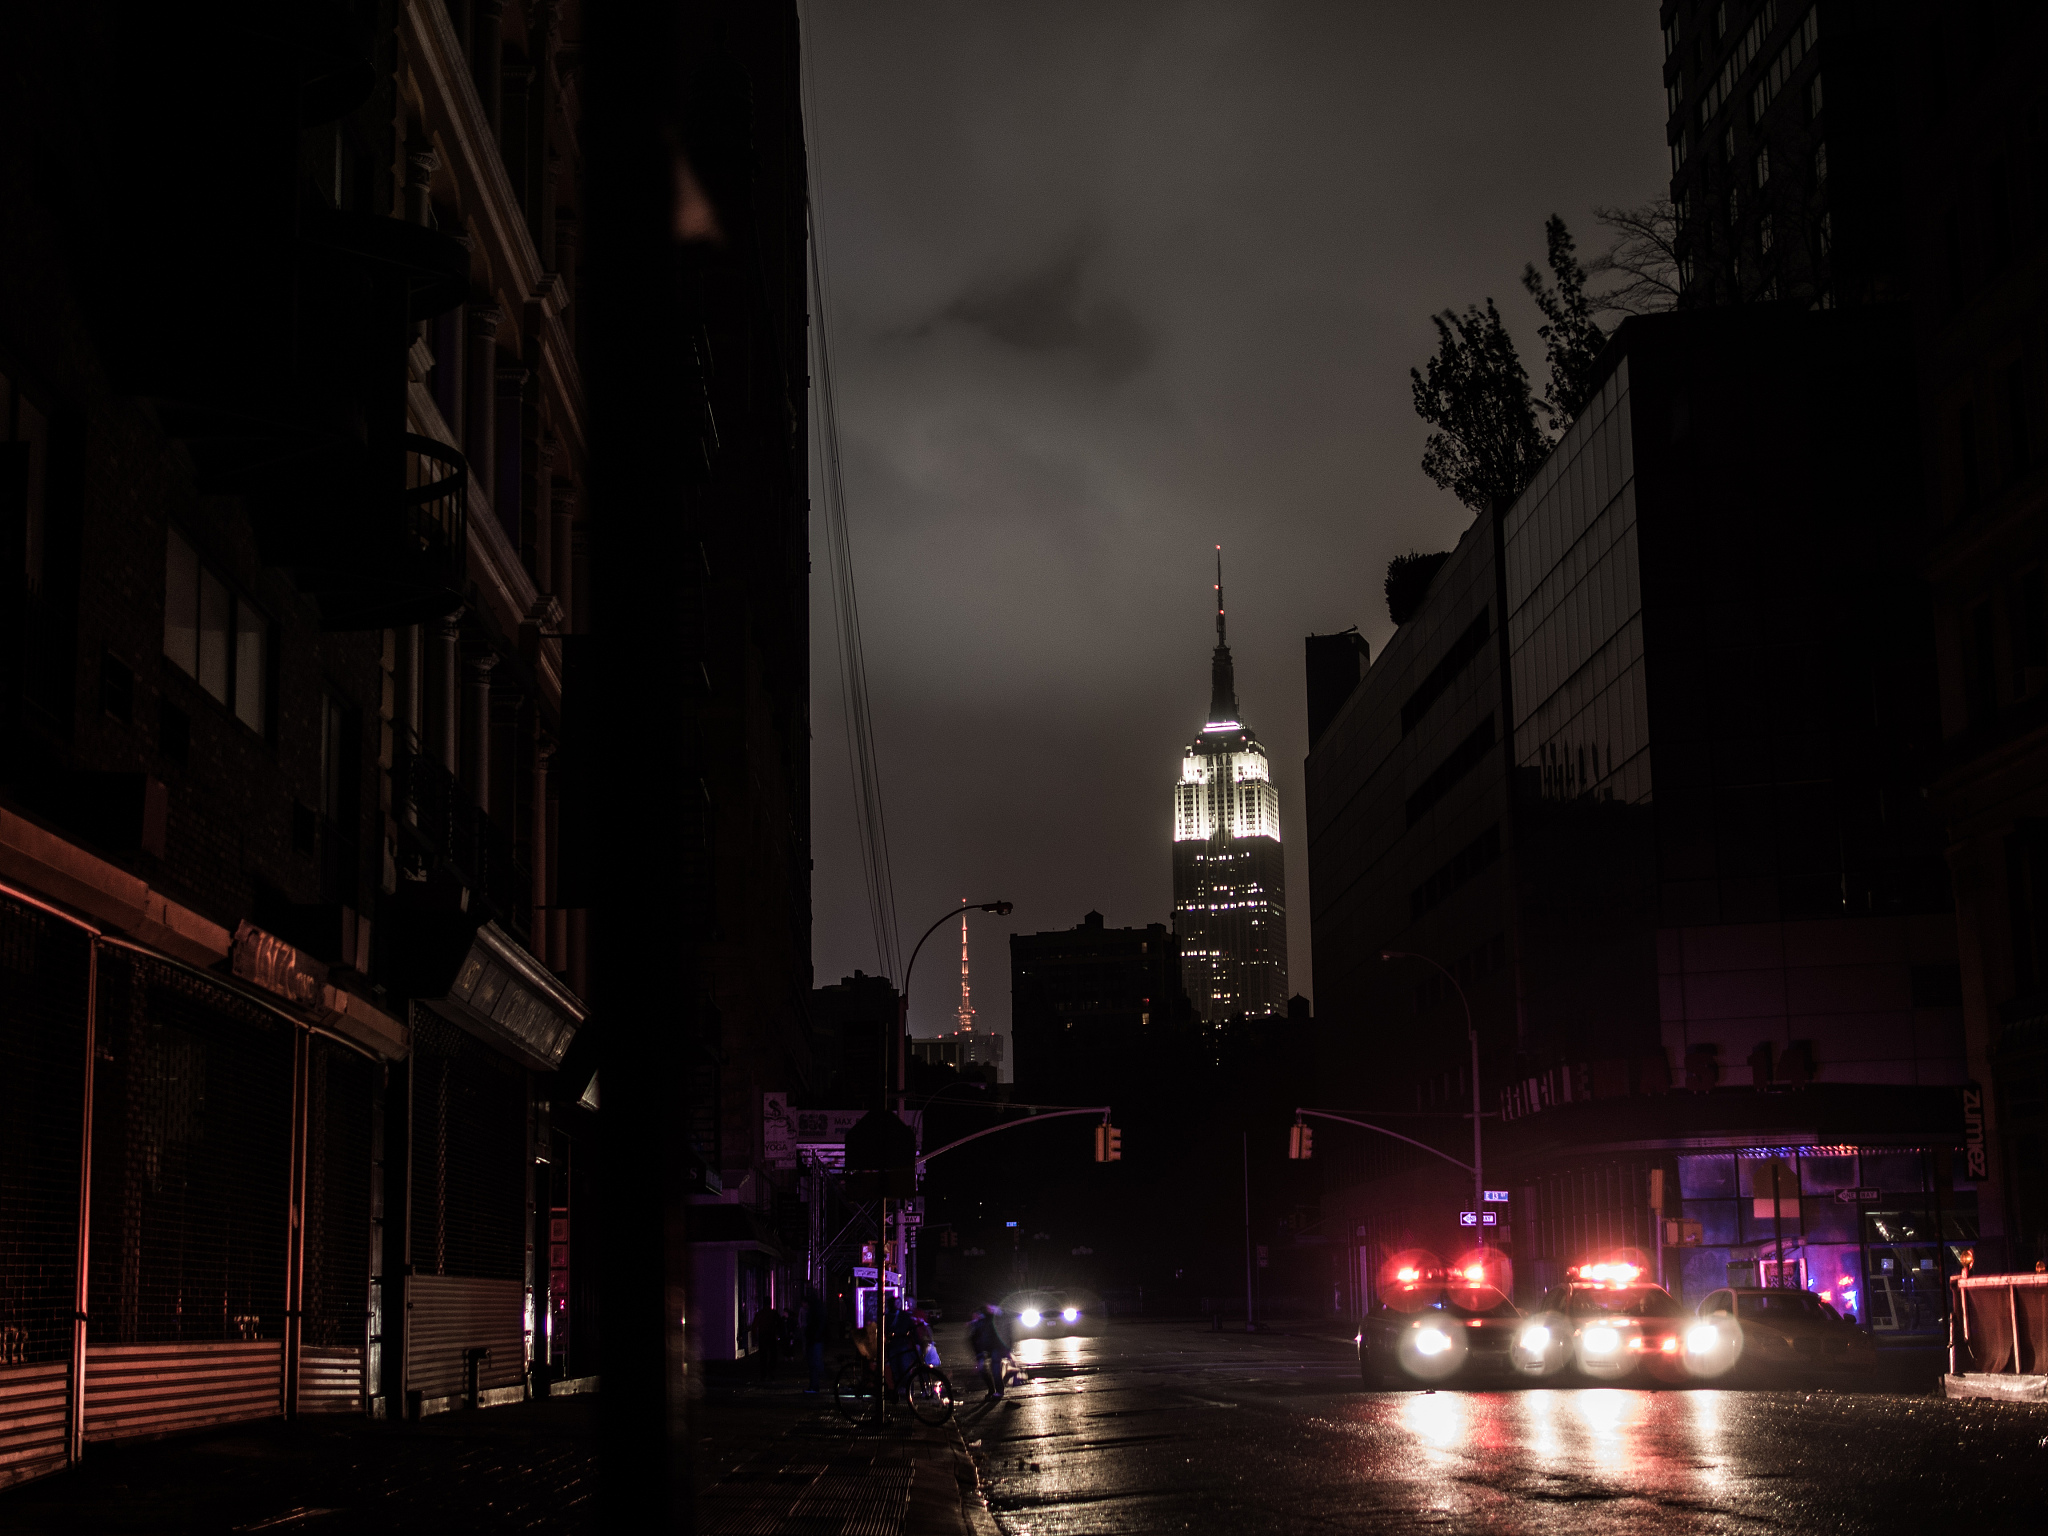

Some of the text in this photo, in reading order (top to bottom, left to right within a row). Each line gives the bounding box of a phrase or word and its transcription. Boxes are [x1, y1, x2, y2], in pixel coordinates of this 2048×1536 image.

[1963, 1089, 1986, 1178] zumiez
[765, 1143, 788, 1152] YOGA
[1861, 1191, 1876, 1199] WAY
